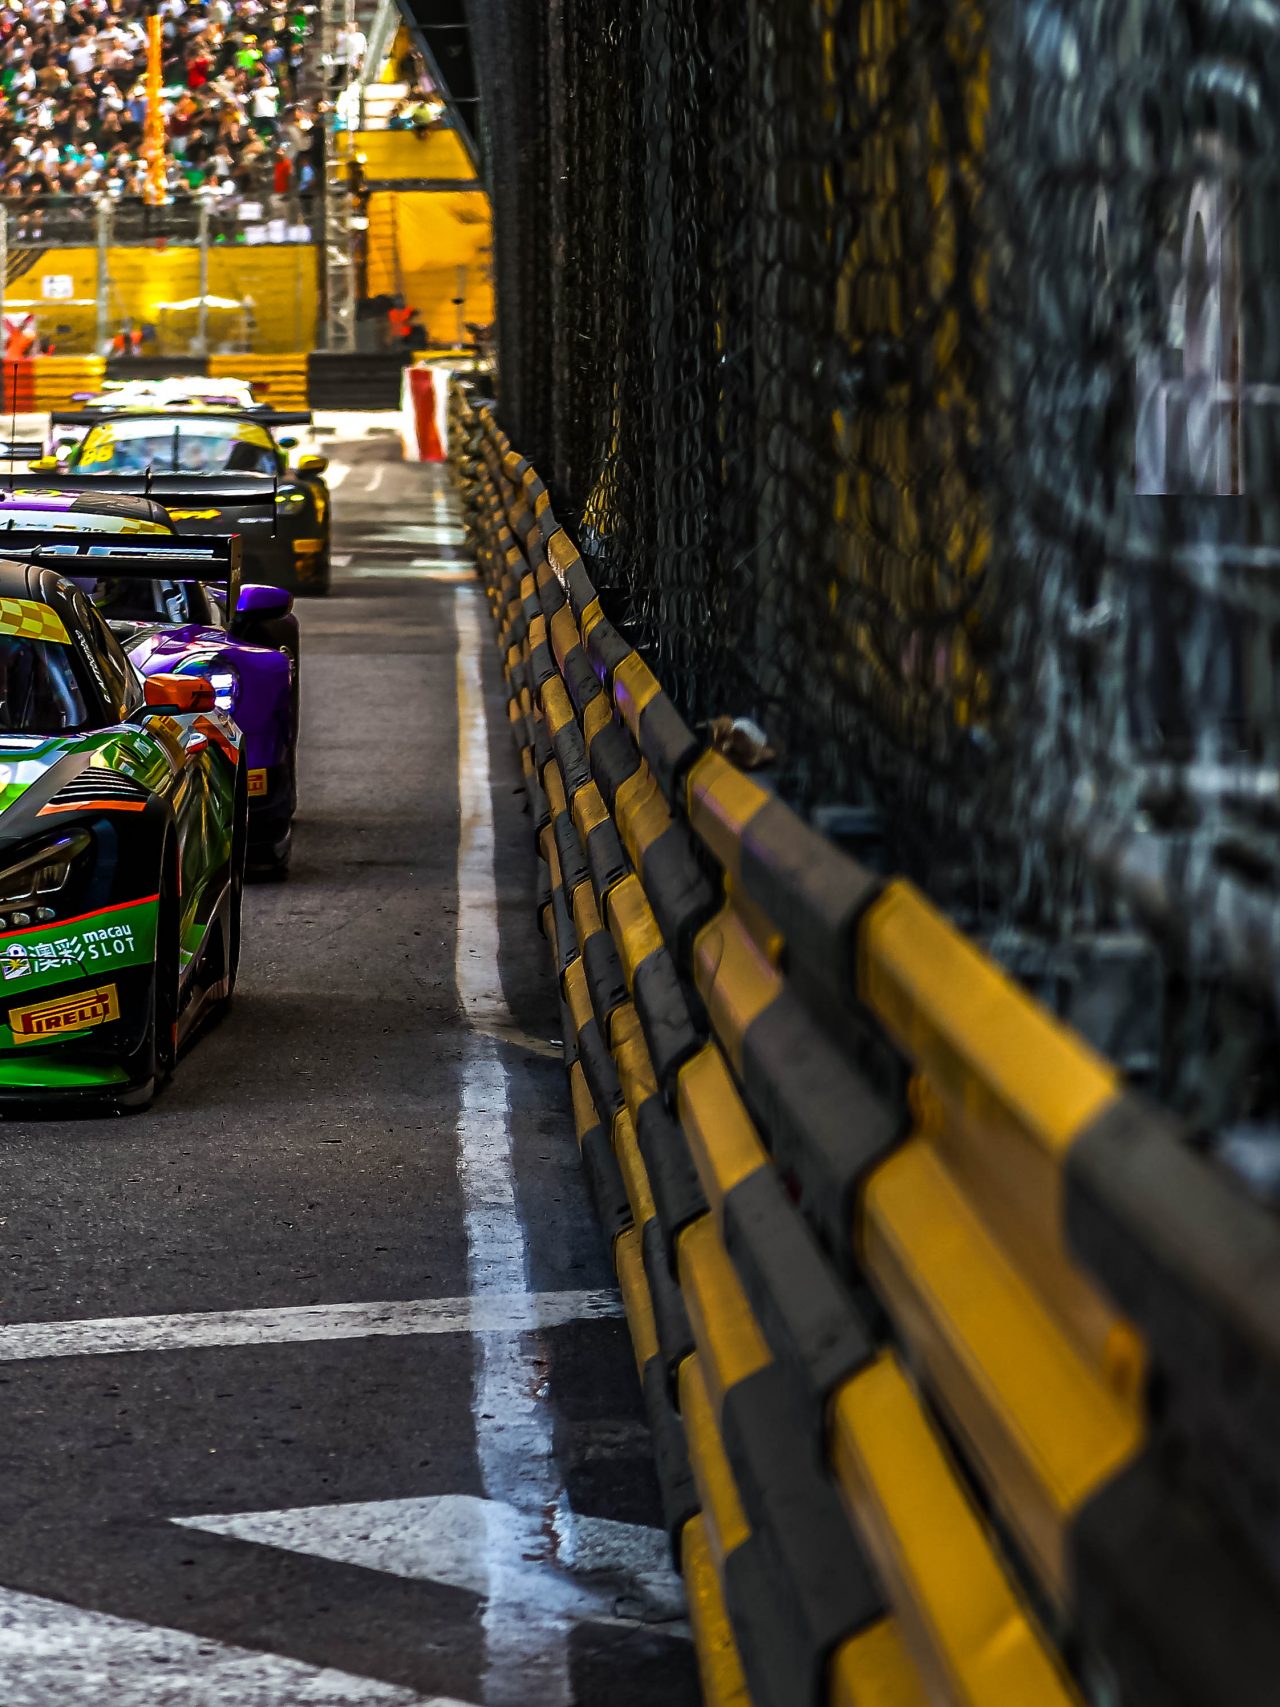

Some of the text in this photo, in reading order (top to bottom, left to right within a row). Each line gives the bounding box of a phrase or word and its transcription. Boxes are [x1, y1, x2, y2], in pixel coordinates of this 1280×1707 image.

[83, 924, 132, 944] macau
[88, 937, 134, 960] SLOT
[27, 935, 86, 973] 澳彩
[20, 993, 110, 1033] PIRELLI
